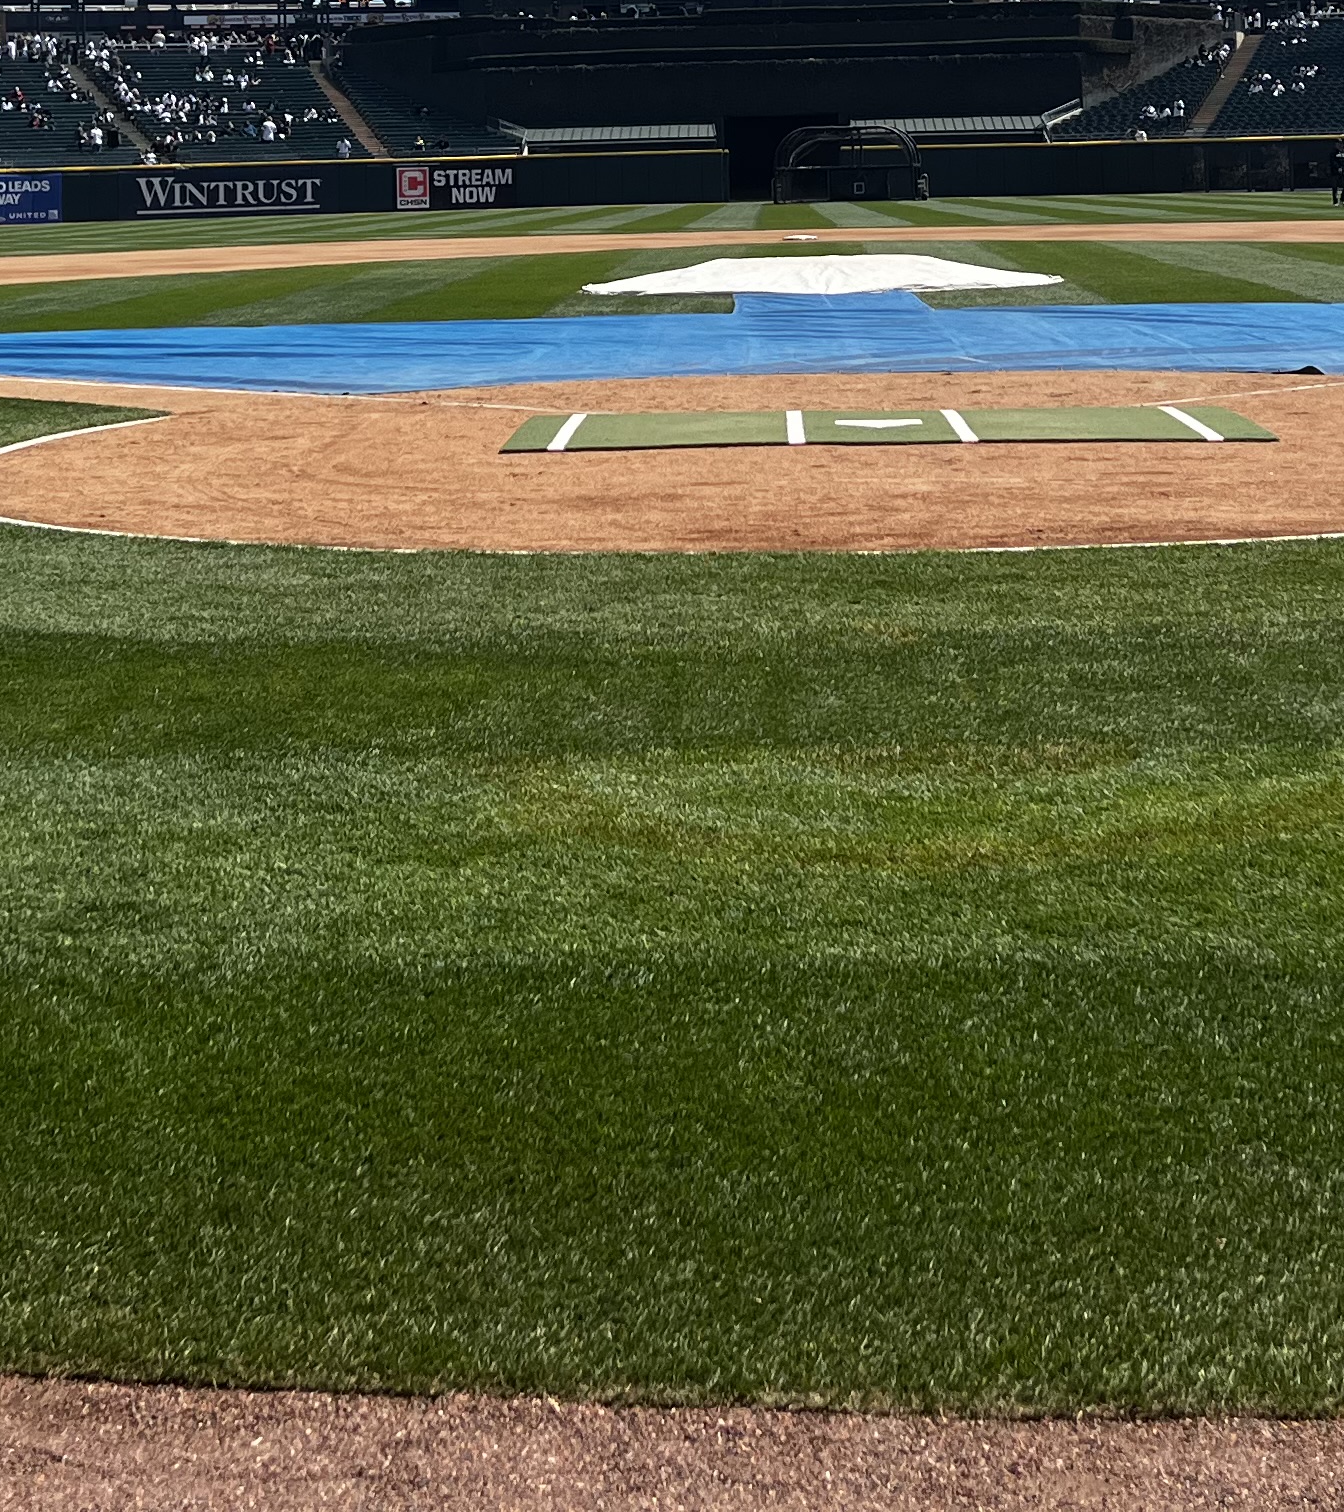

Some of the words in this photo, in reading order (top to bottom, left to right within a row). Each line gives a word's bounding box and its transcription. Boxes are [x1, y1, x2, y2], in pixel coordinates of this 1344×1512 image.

[433, 169, 512, 186] STREAM
[9, 180, 50, 192] LEADS
[136, 177, 321, 208] WINTRUST
[452, 187, 496, 203] NOW
